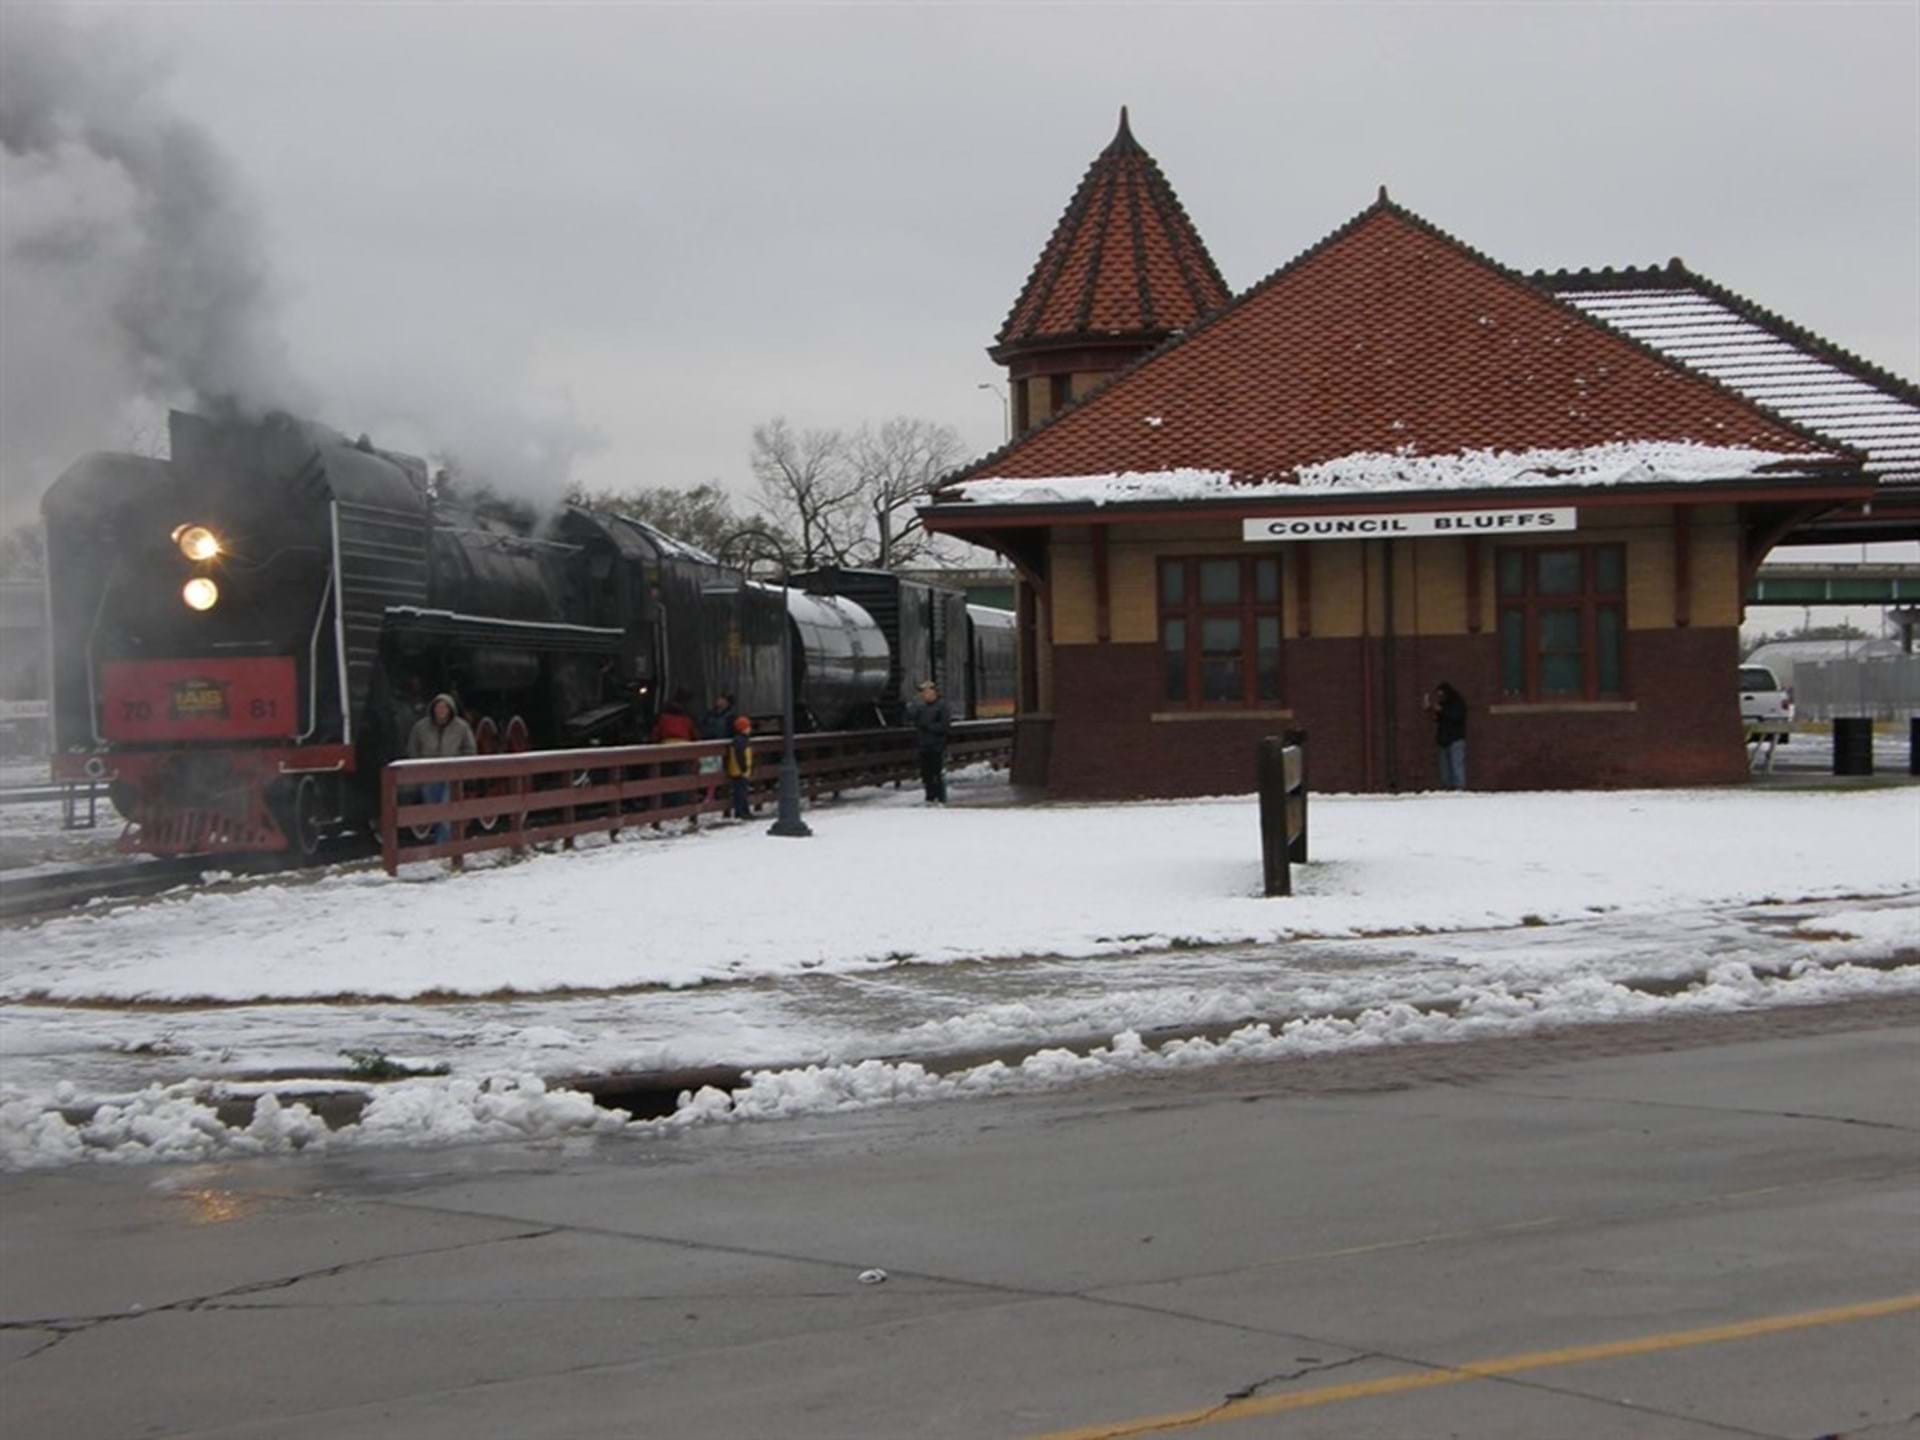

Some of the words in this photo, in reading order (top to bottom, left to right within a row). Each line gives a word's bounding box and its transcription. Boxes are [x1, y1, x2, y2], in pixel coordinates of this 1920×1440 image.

[1268, 519, 1408, 535] COUNCIL
[1434, 512, 1556, 529] BLUFFS
[121, 700, 152, 721] 70
[249, 698, 277, 719] 81
